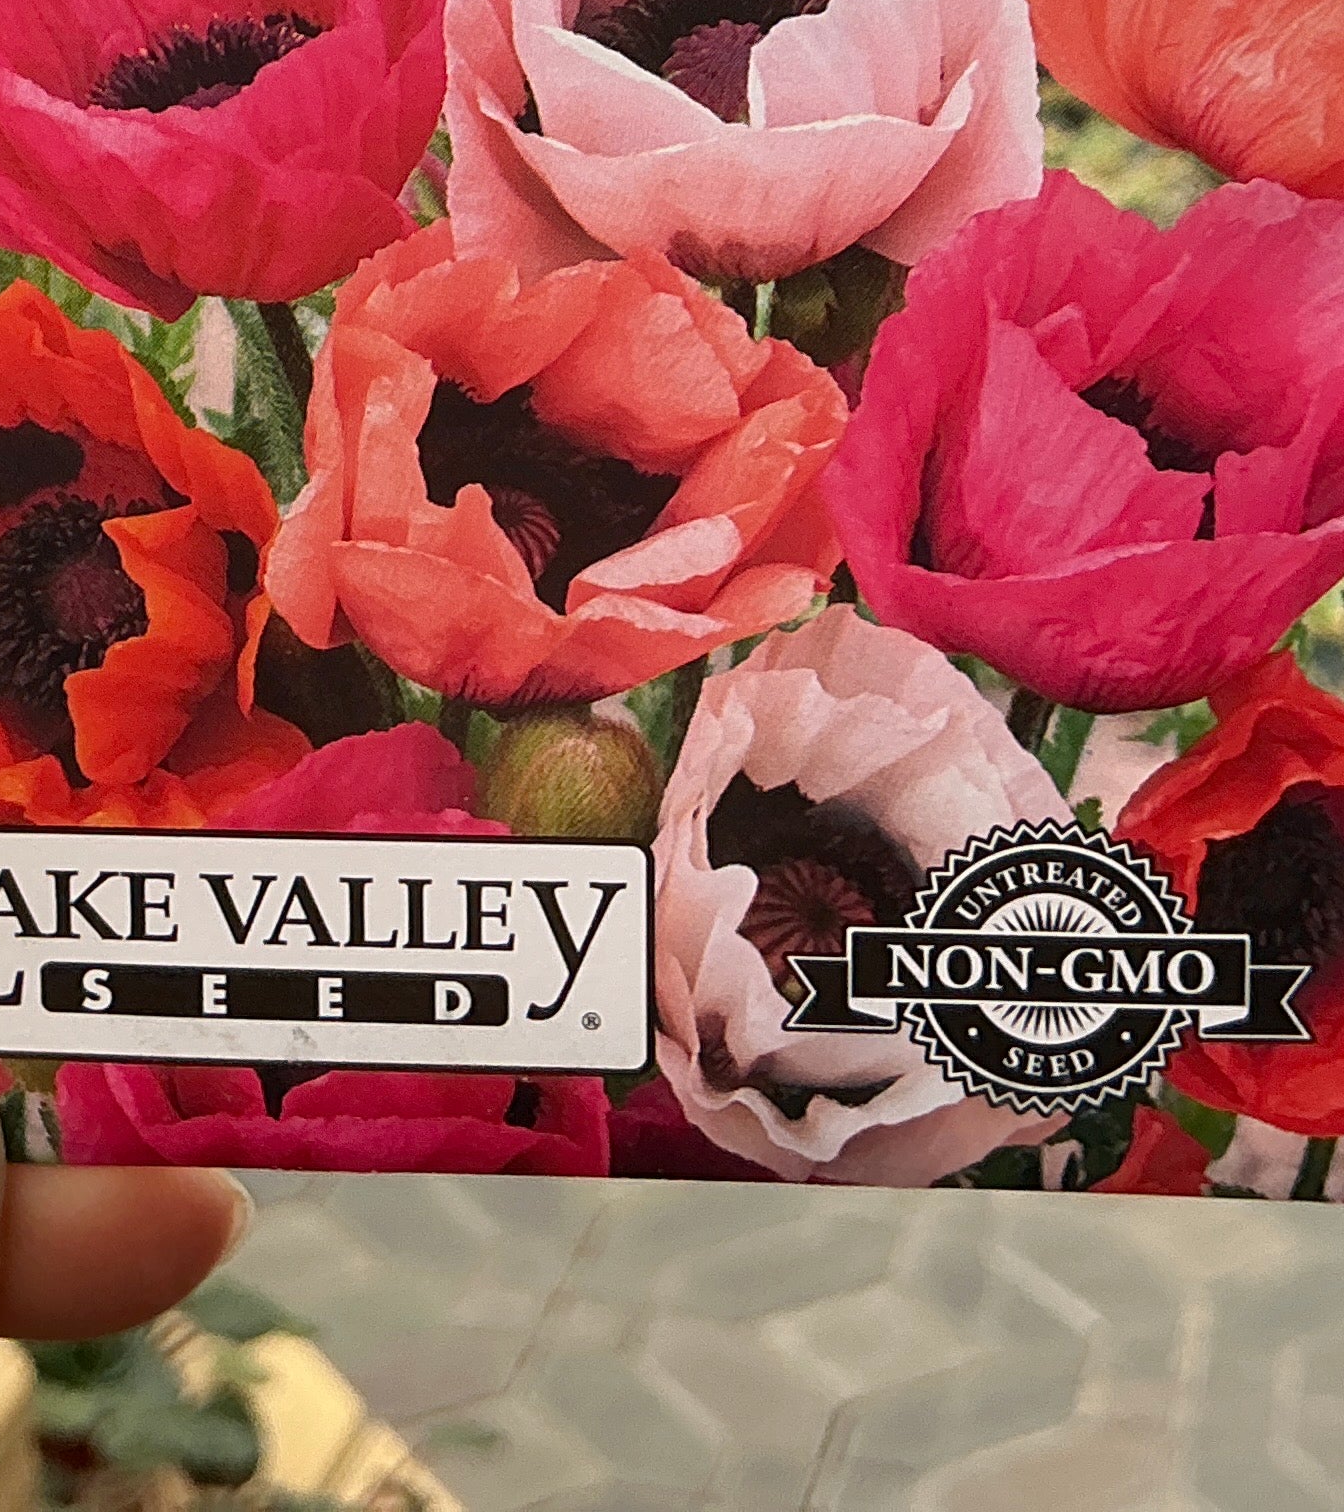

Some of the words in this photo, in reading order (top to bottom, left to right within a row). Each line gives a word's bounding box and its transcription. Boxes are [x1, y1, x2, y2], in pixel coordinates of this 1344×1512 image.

[956, 862, 1142, 927] UNTREATED
[887, 944, 1215, 994] NON-GMO
[82, 969, 472, 1021] SEED
[1003, 1047, 1095, 1077] SEED
